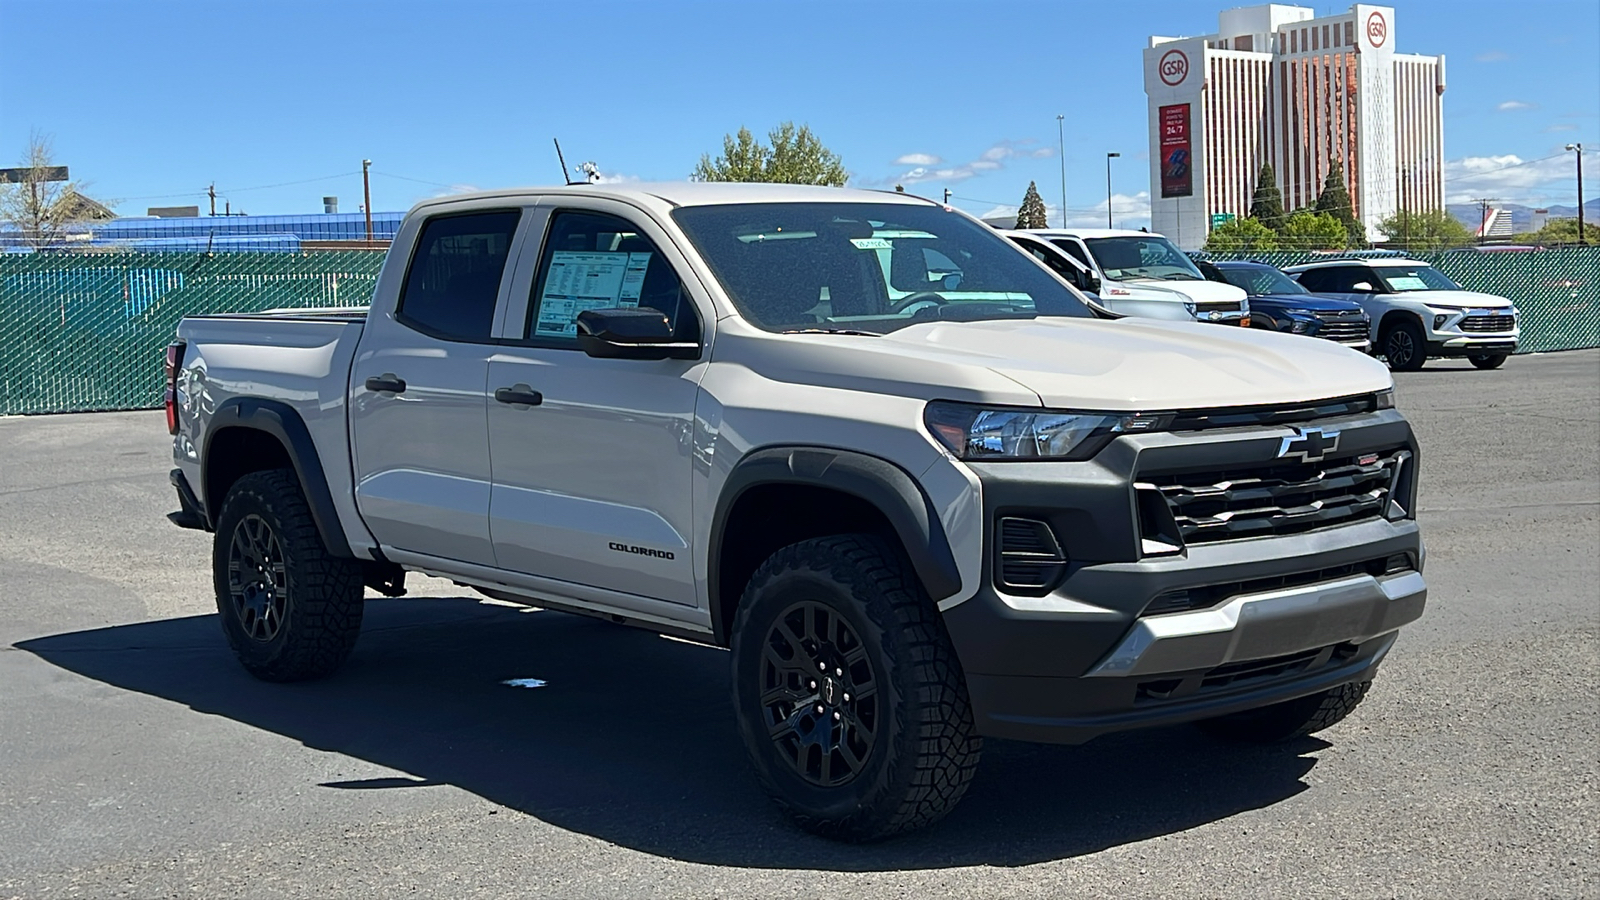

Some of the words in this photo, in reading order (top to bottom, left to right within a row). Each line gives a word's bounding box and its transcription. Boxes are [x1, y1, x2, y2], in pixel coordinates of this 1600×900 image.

[1370, 22, 1384, 37] GSR
[1163, 60, 1184, 76] GSR
[1166, 125, 1183, 135] 24/7
[608, 541, 675, 560] COLORADO
